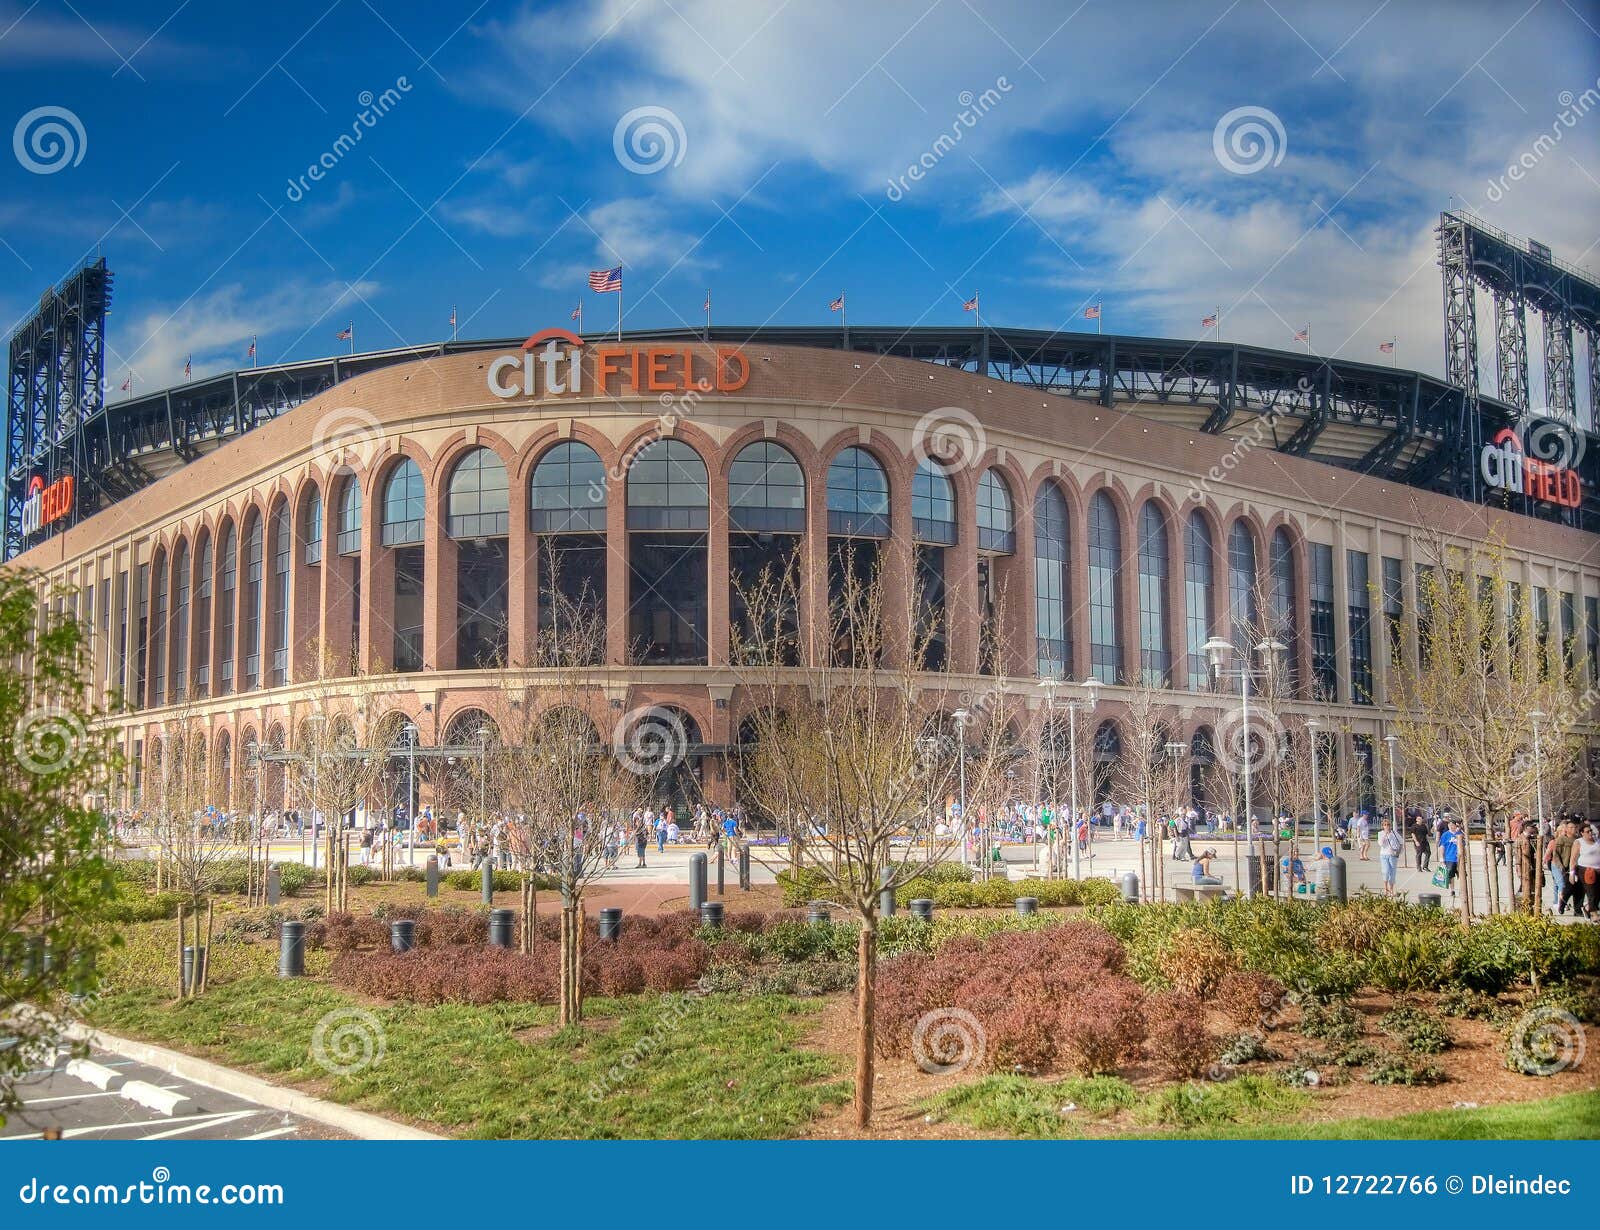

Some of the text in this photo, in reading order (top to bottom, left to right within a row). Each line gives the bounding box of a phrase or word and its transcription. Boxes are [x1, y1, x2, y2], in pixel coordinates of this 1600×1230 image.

[487, 329, 750, 398] citi FIELD
[41, 476, 74, 527] FIELD
[1522, 456, 1581, 508] FIELD
